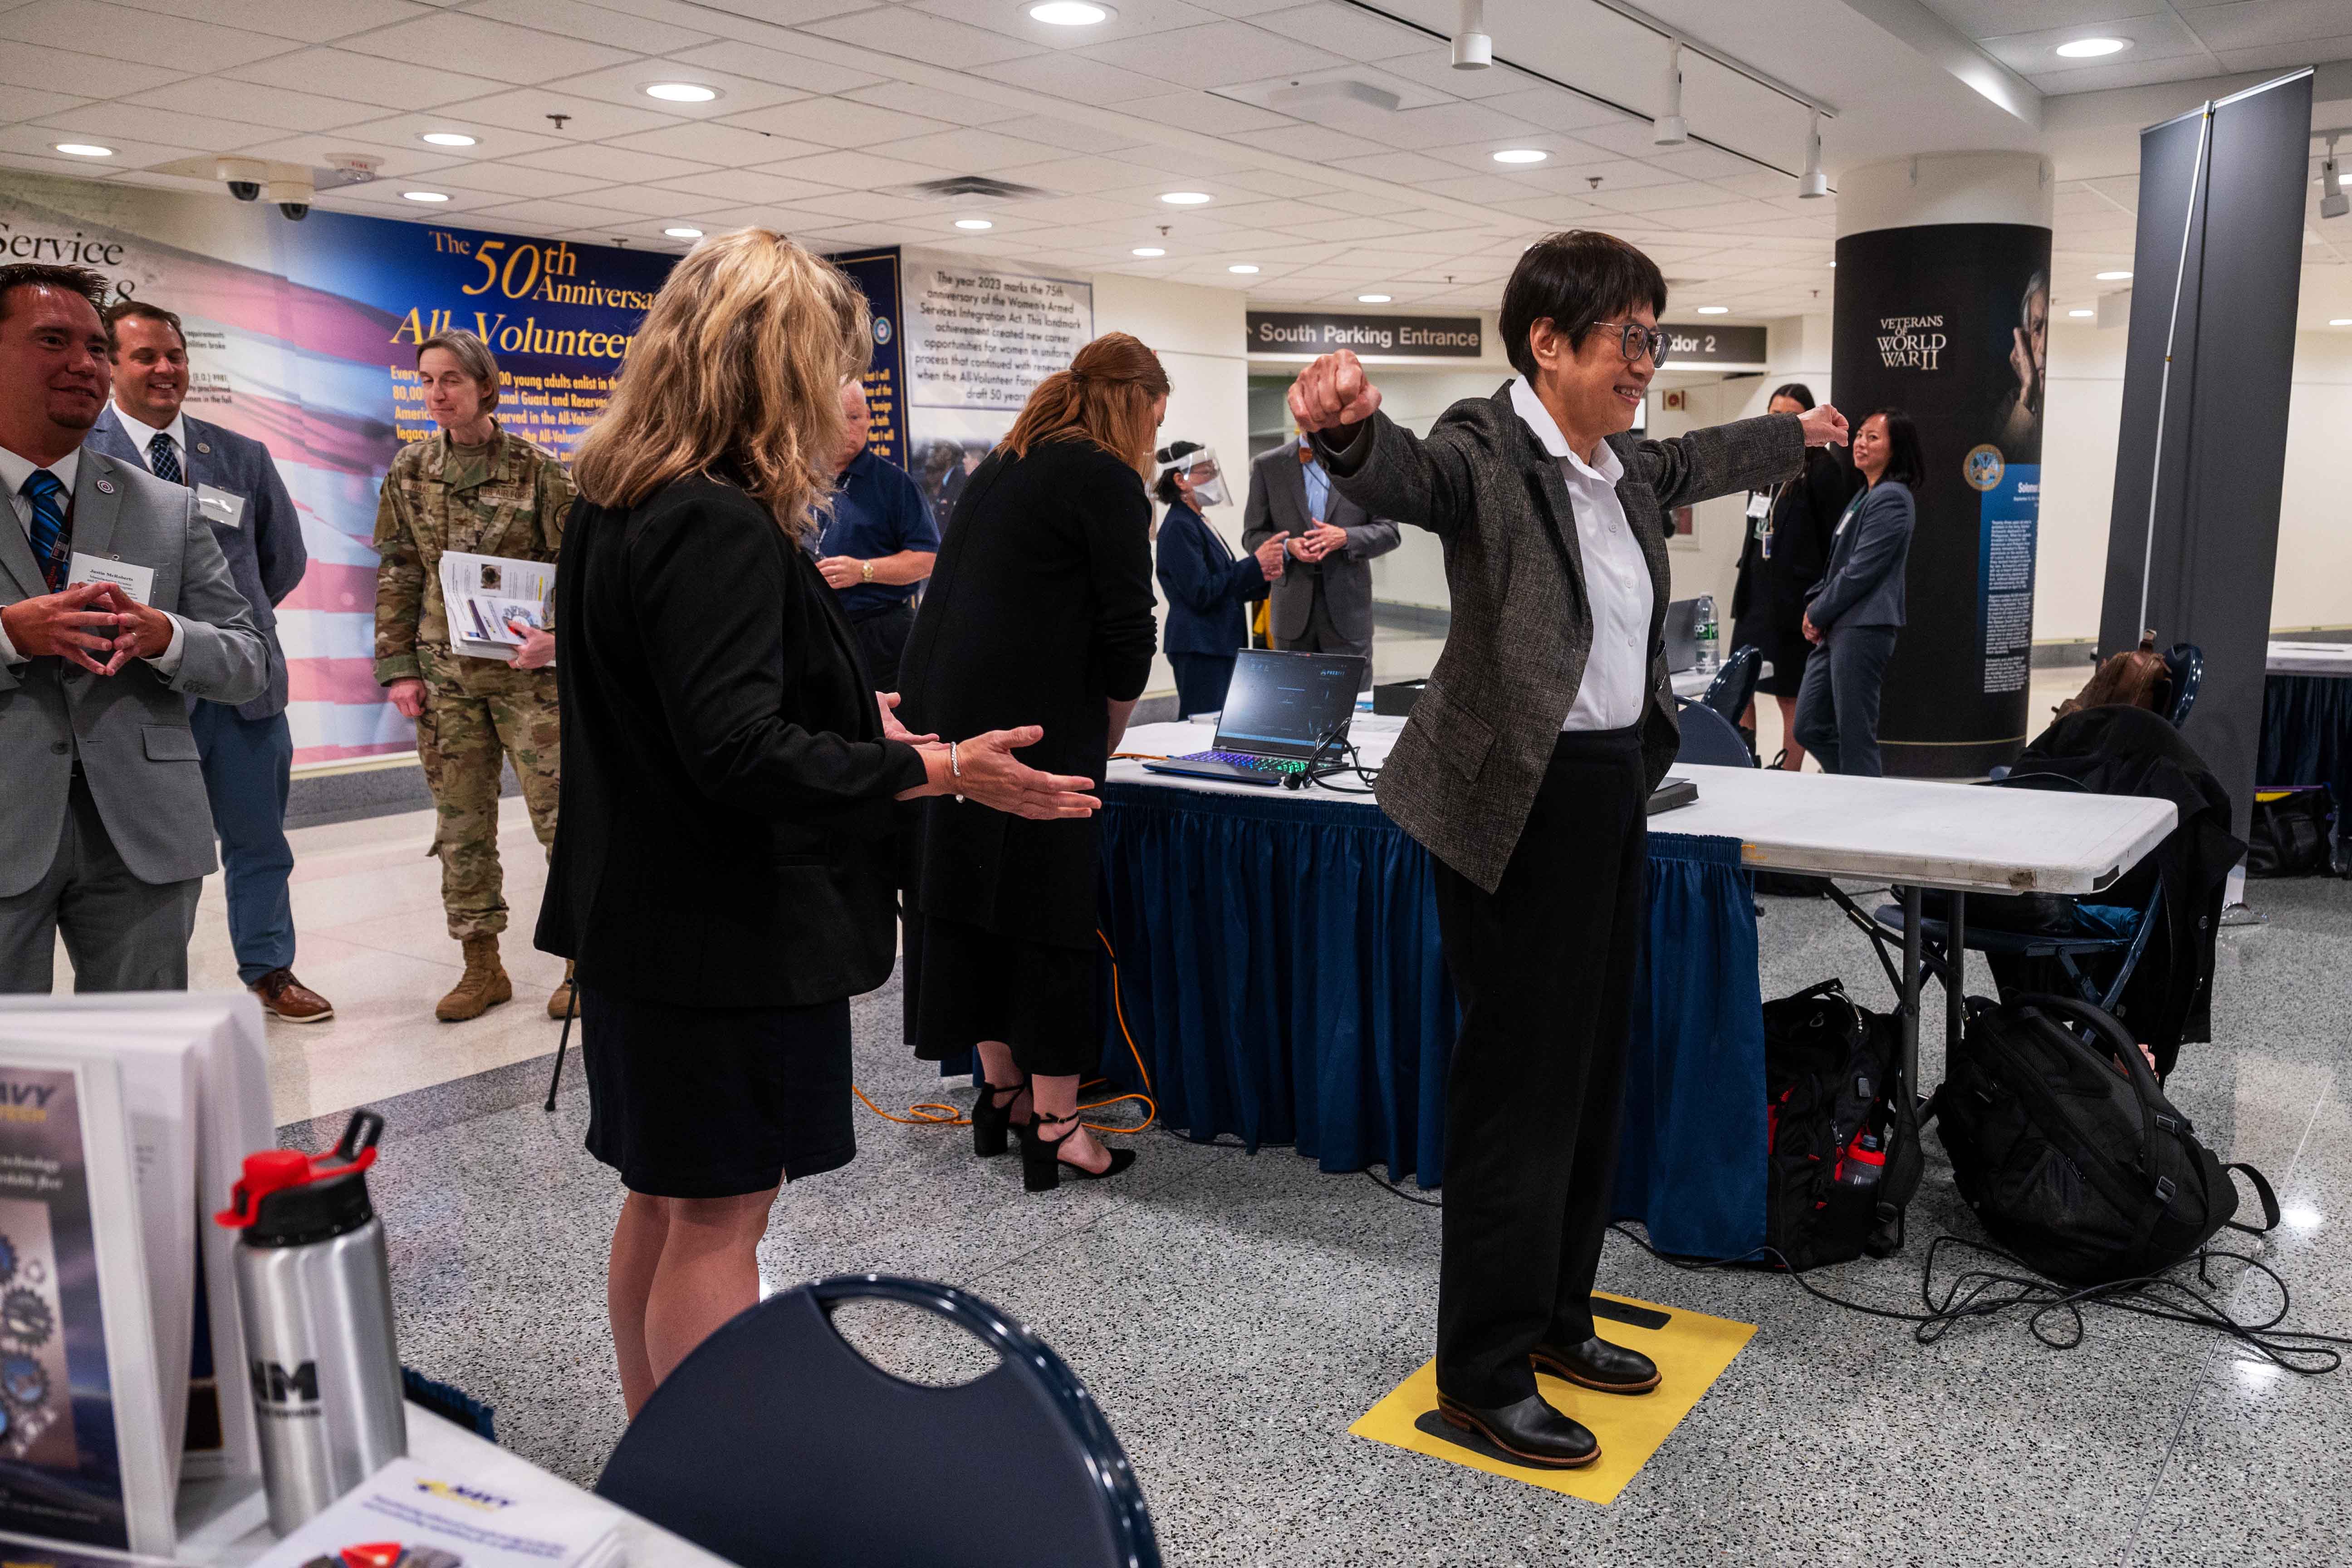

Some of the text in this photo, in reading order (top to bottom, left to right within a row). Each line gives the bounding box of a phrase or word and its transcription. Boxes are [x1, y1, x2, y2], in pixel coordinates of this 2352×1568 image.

[428, 230, 577, 299] The 50th
[532, 275, 653, 310] Anniversa
[937, 270, 1064, 297] The year 2023 marks the 75th
[926, 290, 1074, 314] anniversary of the Women's Armed
[920, 302, 956, 317] Services
[959, 306, 1006, 323] Integration
[1027, 313, 1042, 326] This
[1044, 314, 1081, 329] landmark
[1880, 315, 1944, 330] VETERANS
[935, 320, 1070, 343] achievement created new career
[1259, 322, 1480, 348] South Parking Entrance
[1895, 327, 1908, 337] OF
[924, 339, 982, 352] opportunities
[984, 340, 996, 353] for
[1000, 346, 1028, 355] women
[1030, 345, 1039, 355] in
[1704, 335, 1716, 353] 2
[1876, 333, 1947, 352] WORLD
[915, 355, 949, 366] process
[951, 353, 968, 366] that
[970, 357, 1012, 370] continued
[1014, 359, 1031, 370] with
[1880, 349, 1940, 371] WAR II
[390, 364, 419, 384] Every
[513, 375, 543, 391] young
[544, 372, 572, 389] adults
[573, 374, 596, 390] enlist
[598, 377, 607, 391] in
[608, 376, 617, 391] th
[916, 368, 941, 382] when
[943, 369, 957, 382] the
[960, 371, 1013, 385] All-Volunteer
[392, 385, 424, 402] 80,00
[521, 391, 549, 406] Guard
[552, 392, 569, 407] and
[966, 386, 988, 399] draft
[990, 388, 1002, 401] 50
[497, 409, 527, 425] served
[529, 411, 539, 424] in
[541, 409, 556, 425] the
[397, 423, 428, 443] legacy
[107, 572, 133, 581] McRoberts
